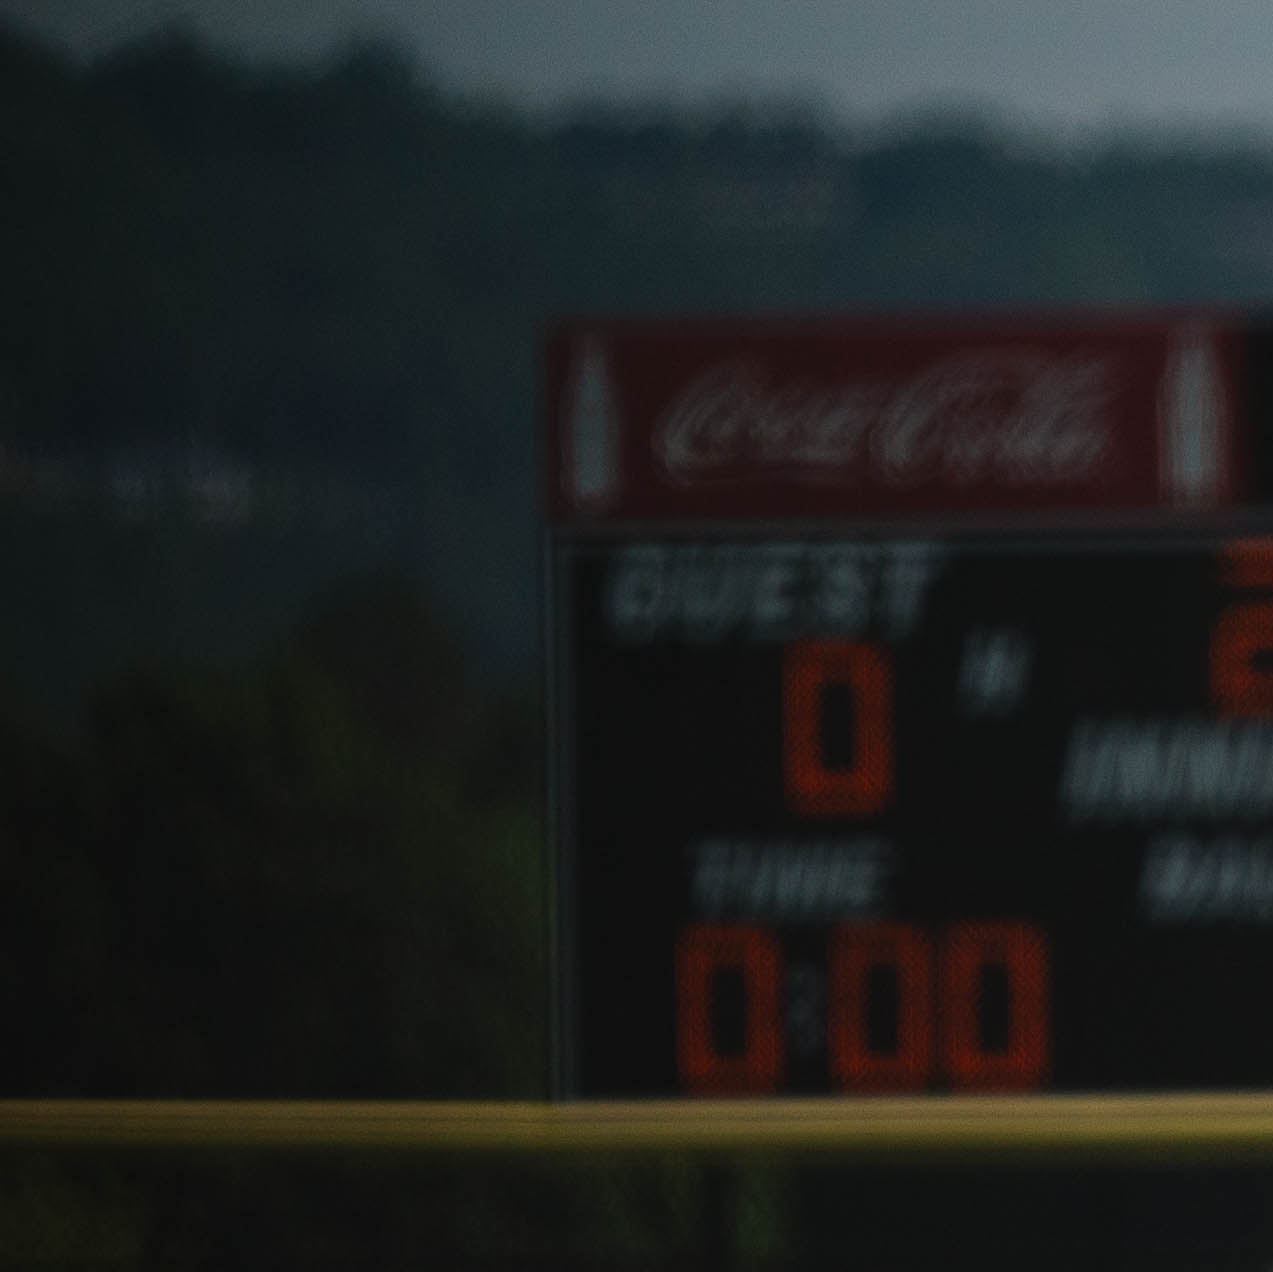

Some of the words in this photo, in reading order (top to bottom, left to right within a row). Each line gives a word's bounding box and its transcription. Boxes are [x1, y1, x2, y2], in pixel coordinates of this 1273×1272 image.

[605, 540, 942, 640] GUEST
[782, 638, 892, 814] 0
[690, 836, 888, 920] TIME
